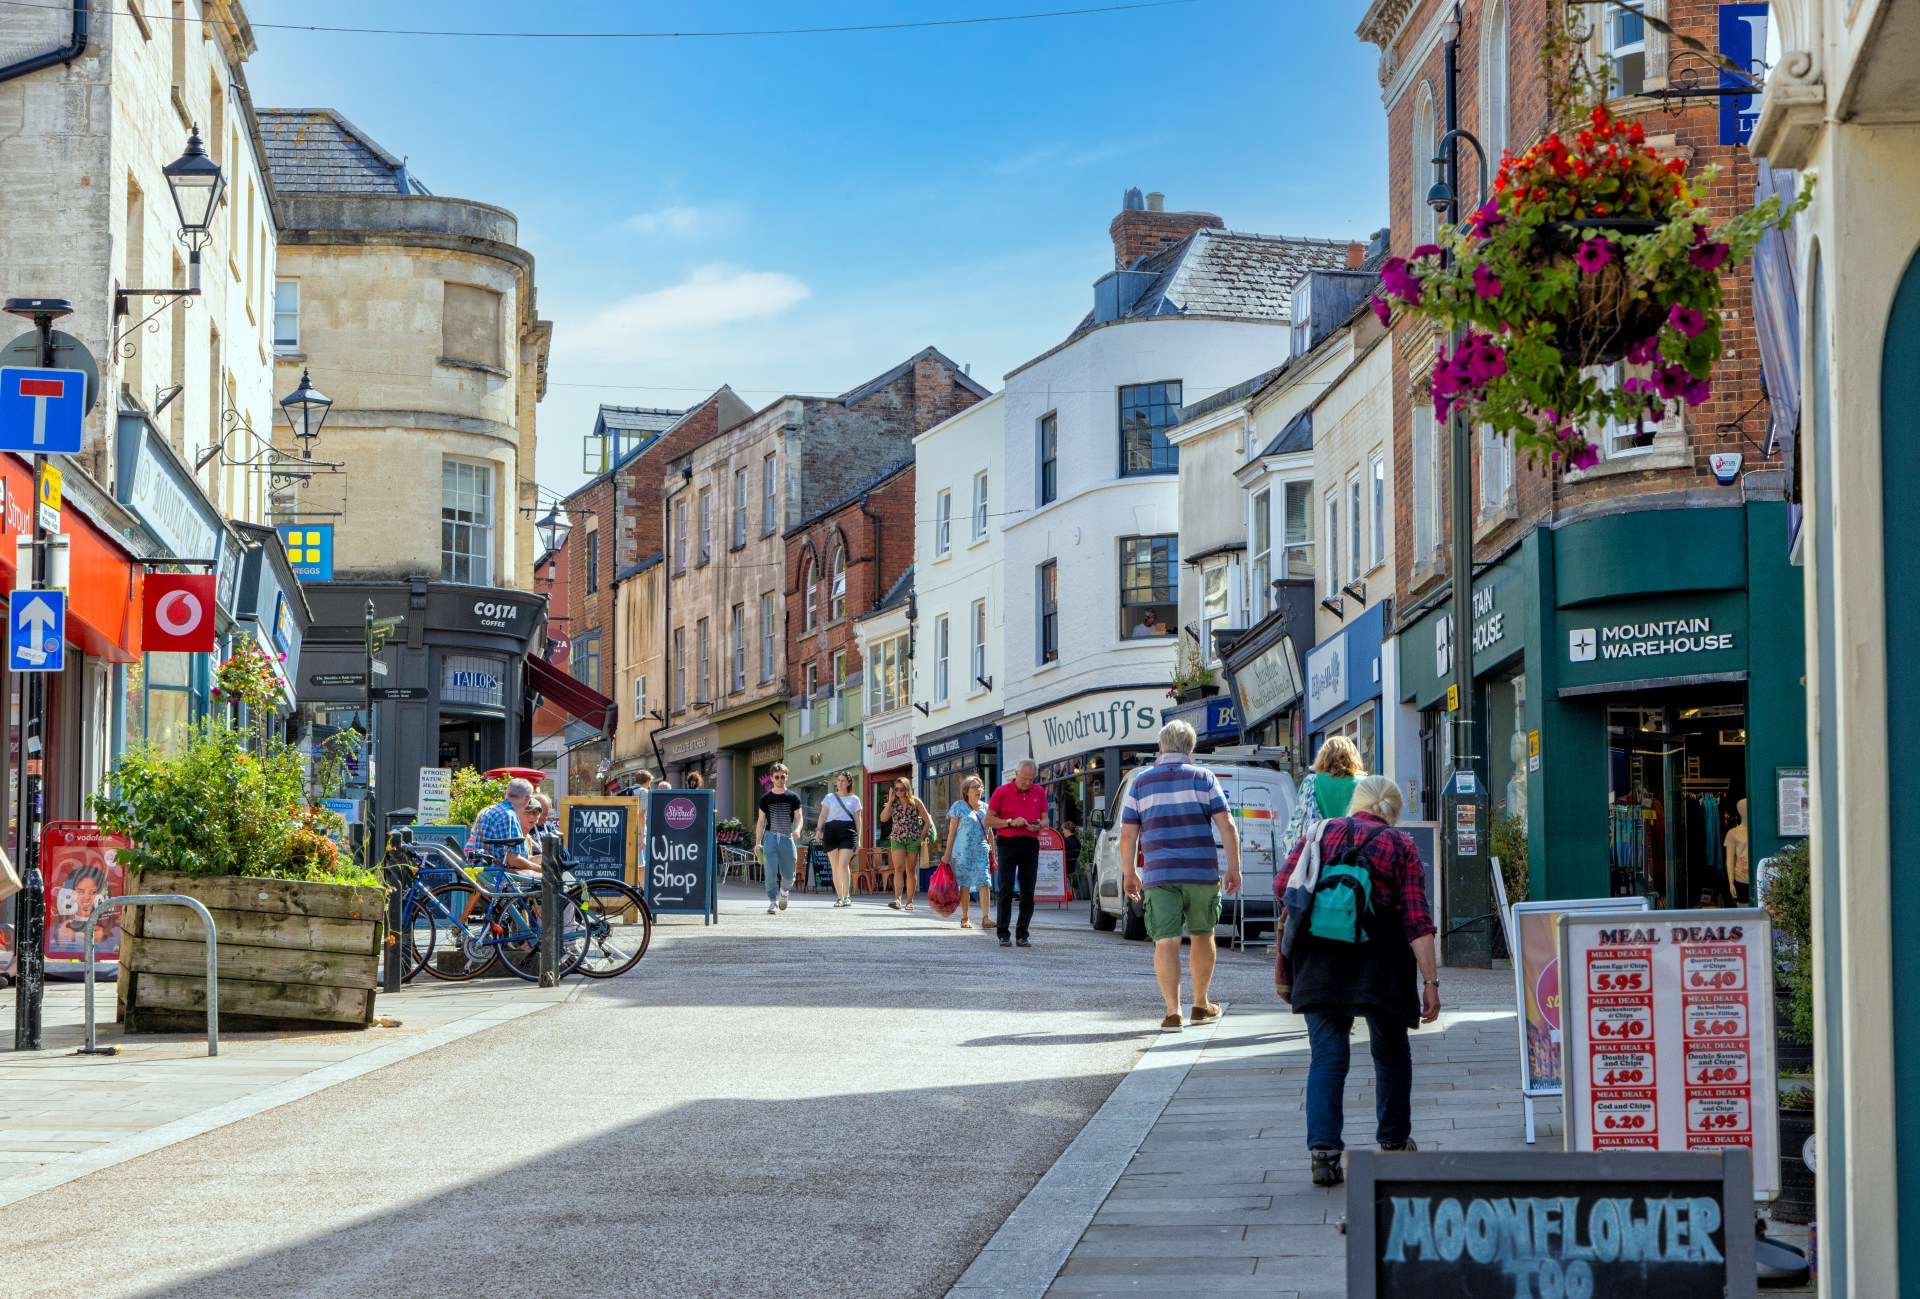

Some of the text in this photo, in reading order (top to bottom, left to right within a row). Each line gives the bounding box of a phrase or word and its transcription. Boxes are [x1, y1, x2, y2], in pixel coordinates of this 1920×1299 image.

[474, 602, 517, 619] COSTA
[481, 619, 506, 628] COFFEE
[1602, 617, 1710, 641] MOUNTAIN
[1602, 633, 1733, 659] WAREHOUSE
[455, 671, 498, 690] TAILORS
[1043, 700, 1156, 748] Woodruffs
[580, 811, 620, 828] YARD
[666, 806, 694, 818] Stroud
[77, 834, 113, 842] vodafone
[652, 835, 698, 861] Wine
[653, 863, 697, 894] Shop
[1598, 926, 1744, 946] MEAL DEALS
[1591, 951, 1614, 959] MEAL
[1597, 973, 1643, 990] 5.95
[1691, 970, 1736, 989] 6.40
[1598, 1020, 1644, 1038] 6.40
[1694, 1020, 1738, 1035] 5.60
[1603, 1069, 1643, 1085] 4.80
[1697, 1067, 1737, 1083] 4.80
[1604, 1115, 1645, 1129] 6.20
[1699, 1114, 1738, 1130] 4.95
[1383, 1196, 1725, 1265] MOONFLOWER
[1501, 1258, 1595, 1299] TOO
